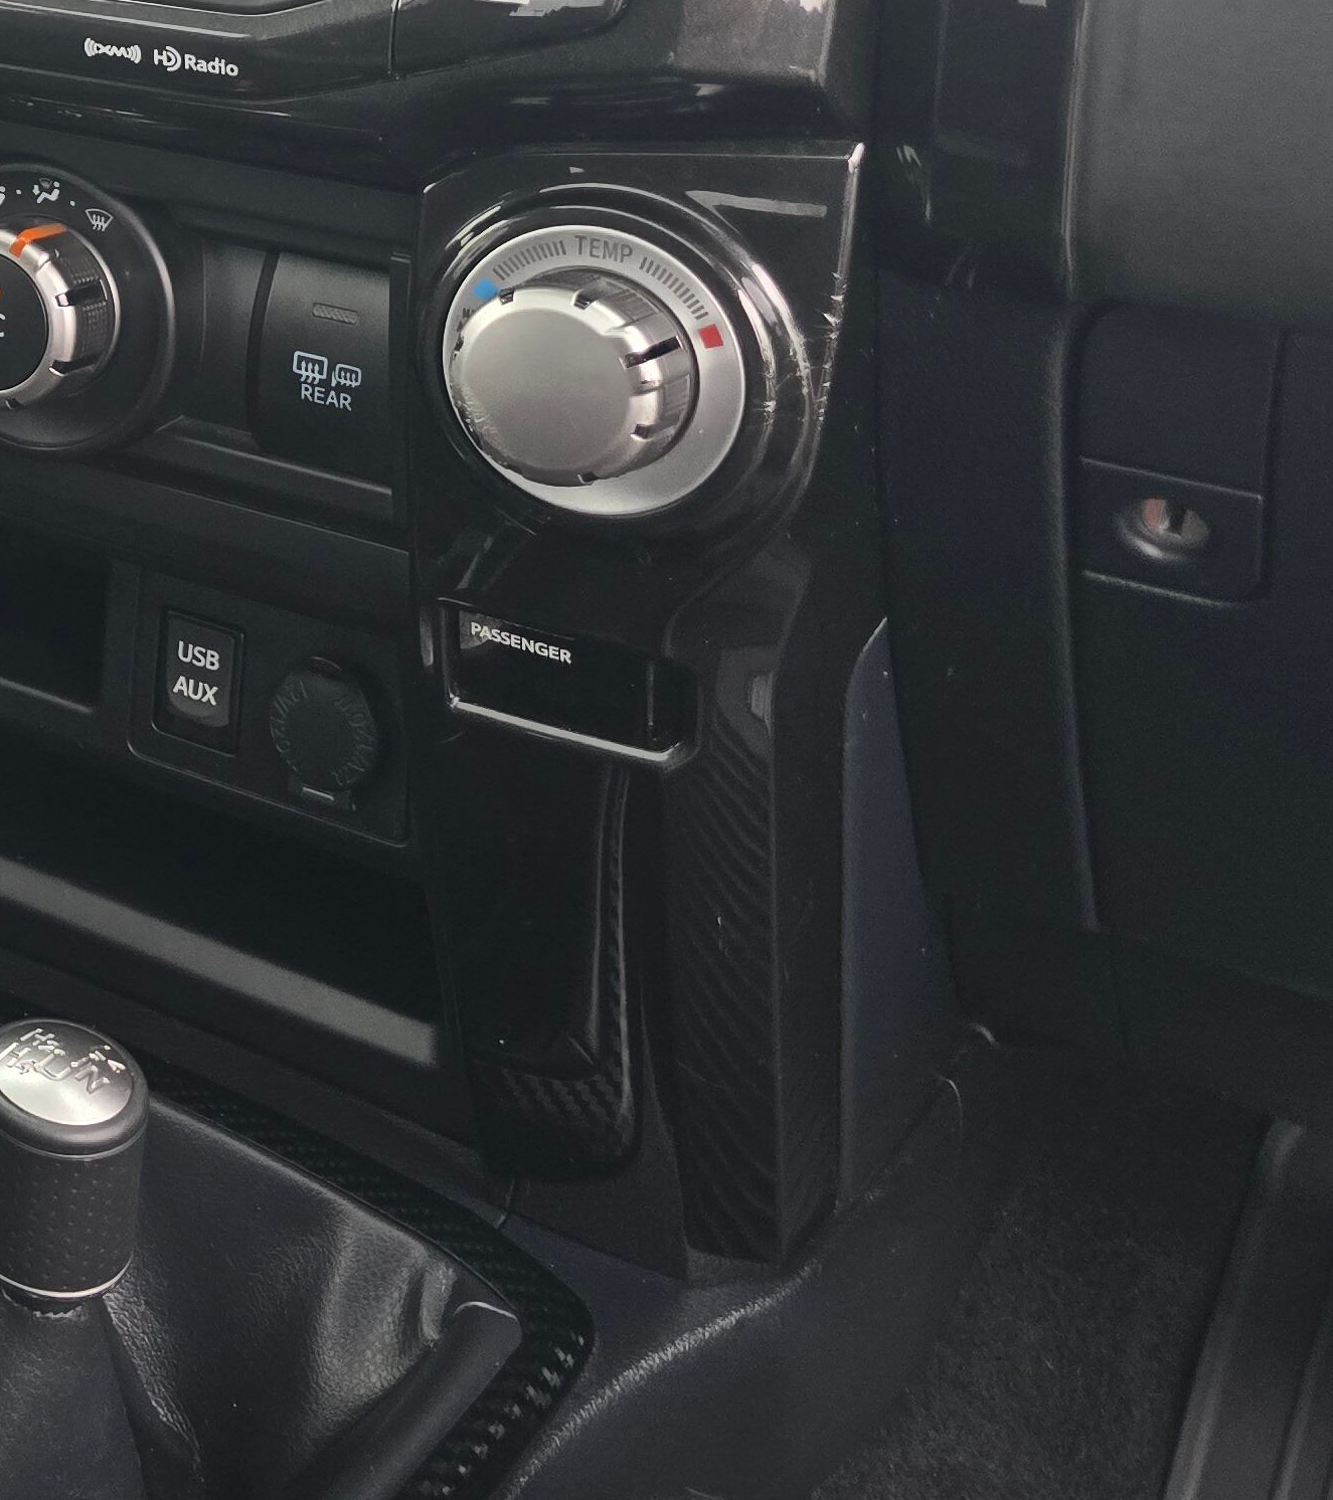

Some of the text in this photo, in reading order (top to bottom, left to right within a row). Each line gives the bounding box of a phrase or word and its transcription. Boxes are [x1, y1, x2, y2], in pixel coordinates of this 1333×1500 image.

[184, 53, 239, 77] Radio
[574, 235, 633, 264] TEMP
[300, 382, 352, 411] REAR
[177, 640, 220, 671] USB
[471, 622, 572, 665] PASSENGER
[172, 675, 219, 706] AUX
